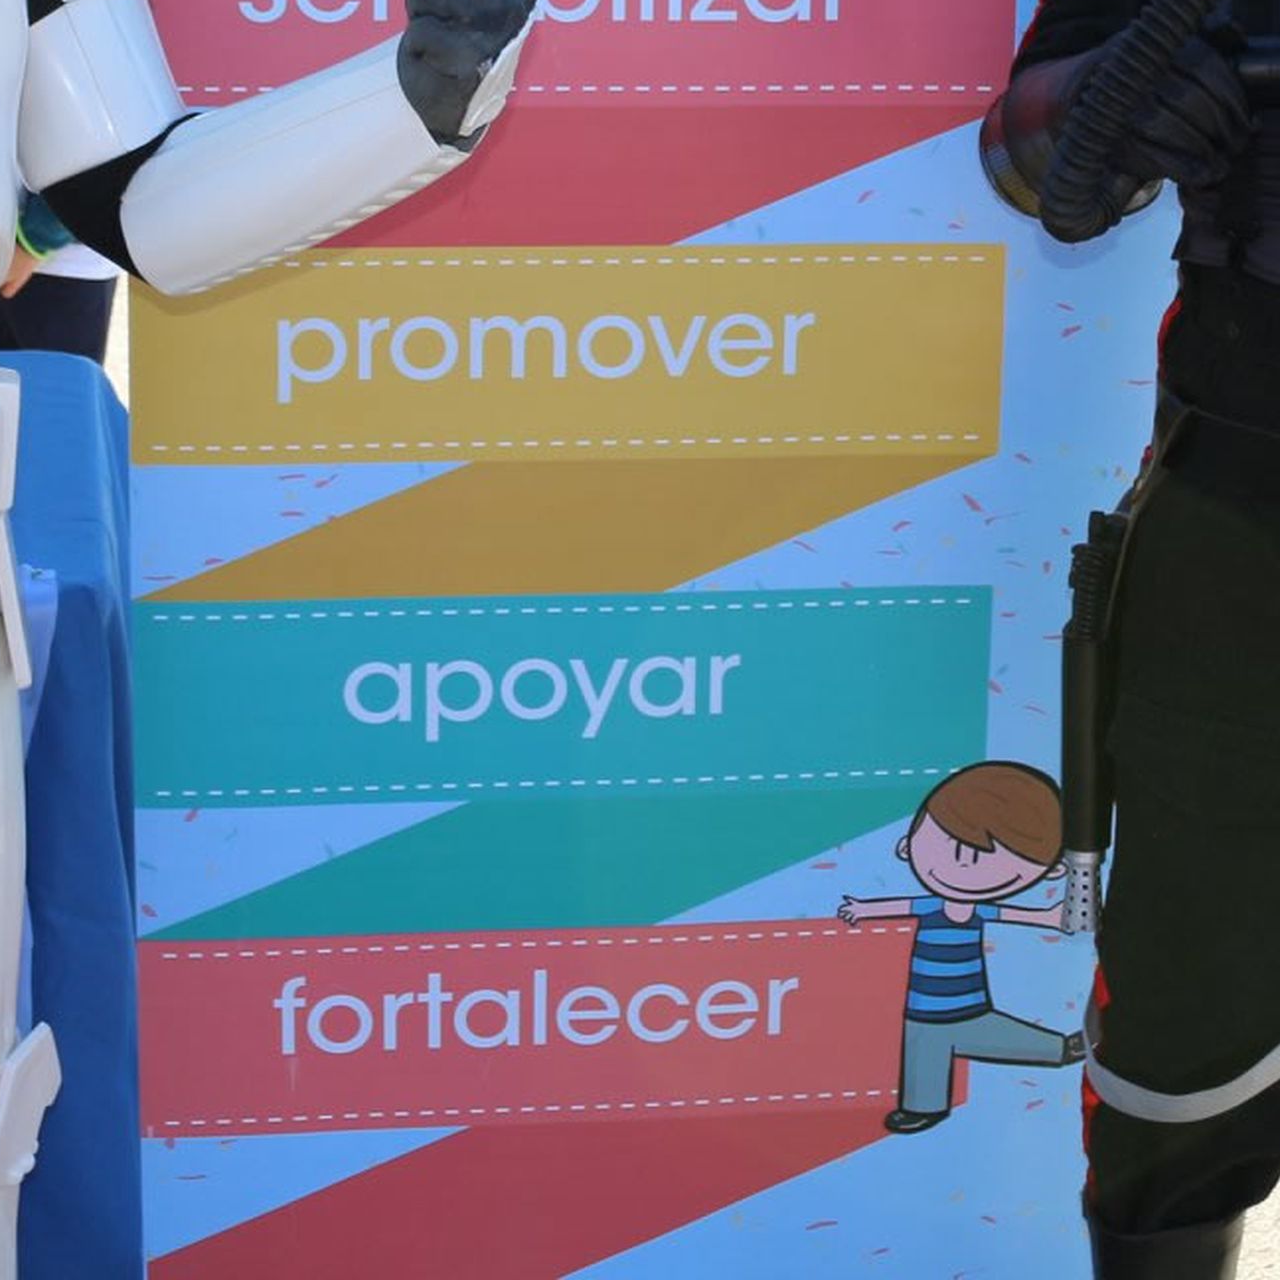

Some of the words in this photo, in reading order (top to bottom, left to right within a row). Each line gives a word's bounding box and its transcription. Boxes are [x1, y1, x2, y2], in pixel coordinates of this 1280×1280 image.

[276, 311, 817, 405] promover
[343, 653, 742, 743] apoyar
[273, 968, 800, 1055] fortalecer
